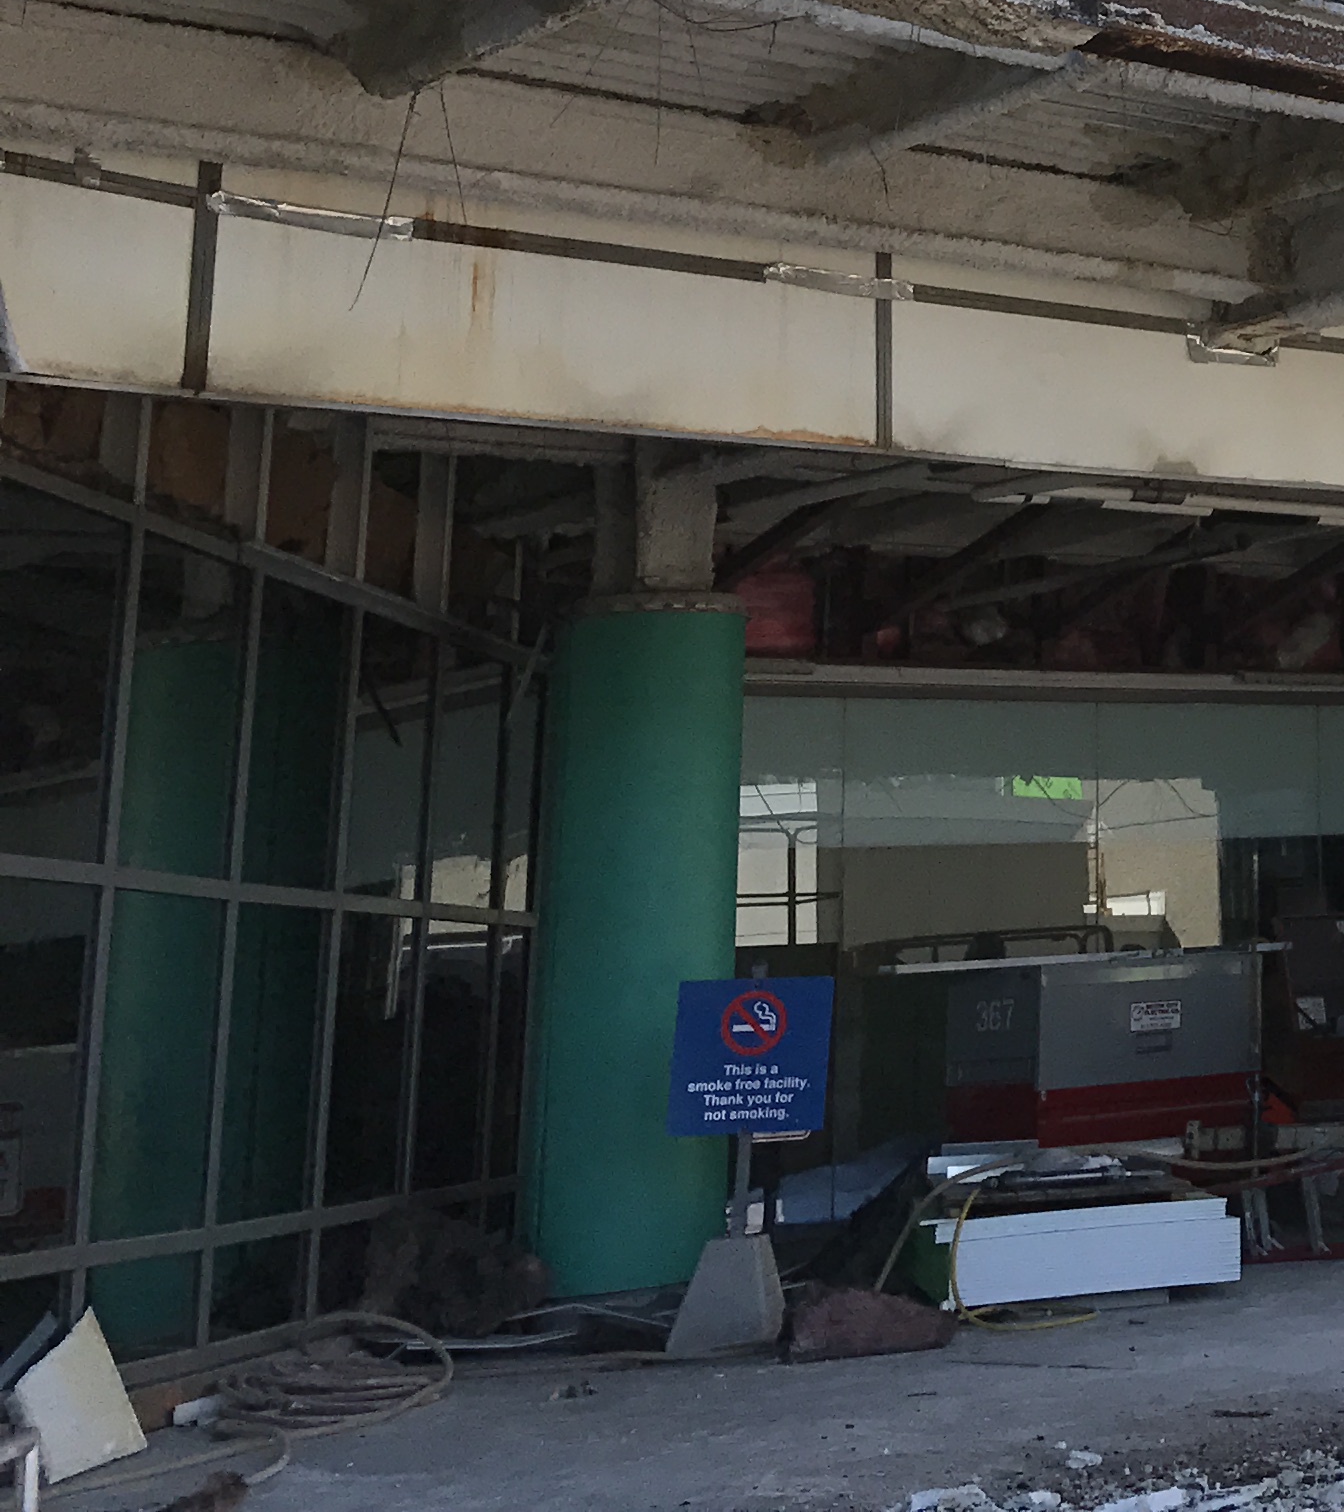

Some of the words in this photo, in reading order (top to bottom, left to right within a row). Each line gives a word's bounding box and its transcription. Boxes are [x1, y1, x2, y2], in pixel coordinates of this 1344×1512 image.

[724, 1064, 752, 1076] This
[755, 1063, 767, 1075] is
[770, 1065, 778, 1074] a
[687, 1080, 732, 1092] smoke
[735, 1078, 761, 1090] free
[764, 1077, 810, 1091] facility.
[703, 1094, 743, 1107] Thank
[747, 1094, 772, 1107] you
[775, 1092, 794, 1103] for
[704, 1110, 726, 1121] not
[729, 1107, 789, 1121] smoking.
